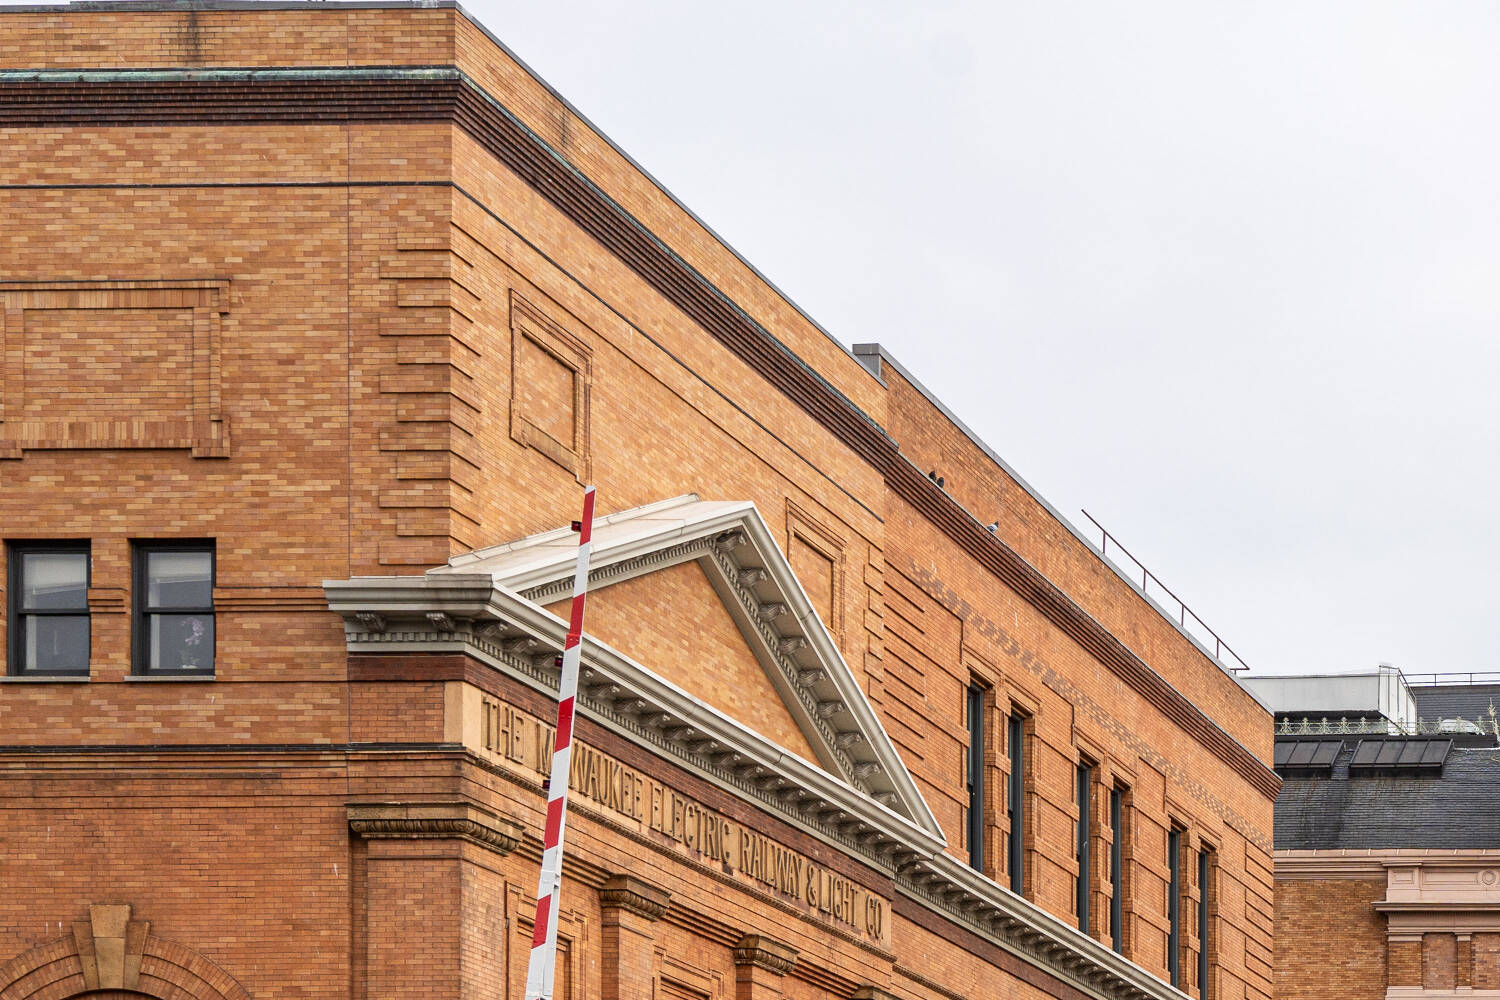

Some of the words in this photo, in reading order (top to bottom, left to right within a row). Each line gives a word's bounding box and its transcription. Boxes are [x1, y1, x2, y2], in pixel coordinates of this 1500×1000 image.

[483, 697, 523, 764] THE
[536, 722, 643, 823] MWAUKEE
[650, 782, 730, 864] ELECTRIC
[739, 828, 802, 899] RAILWAY
[806, 864, 818, 907] &
[818, 869, 858, 927] LIGHT
